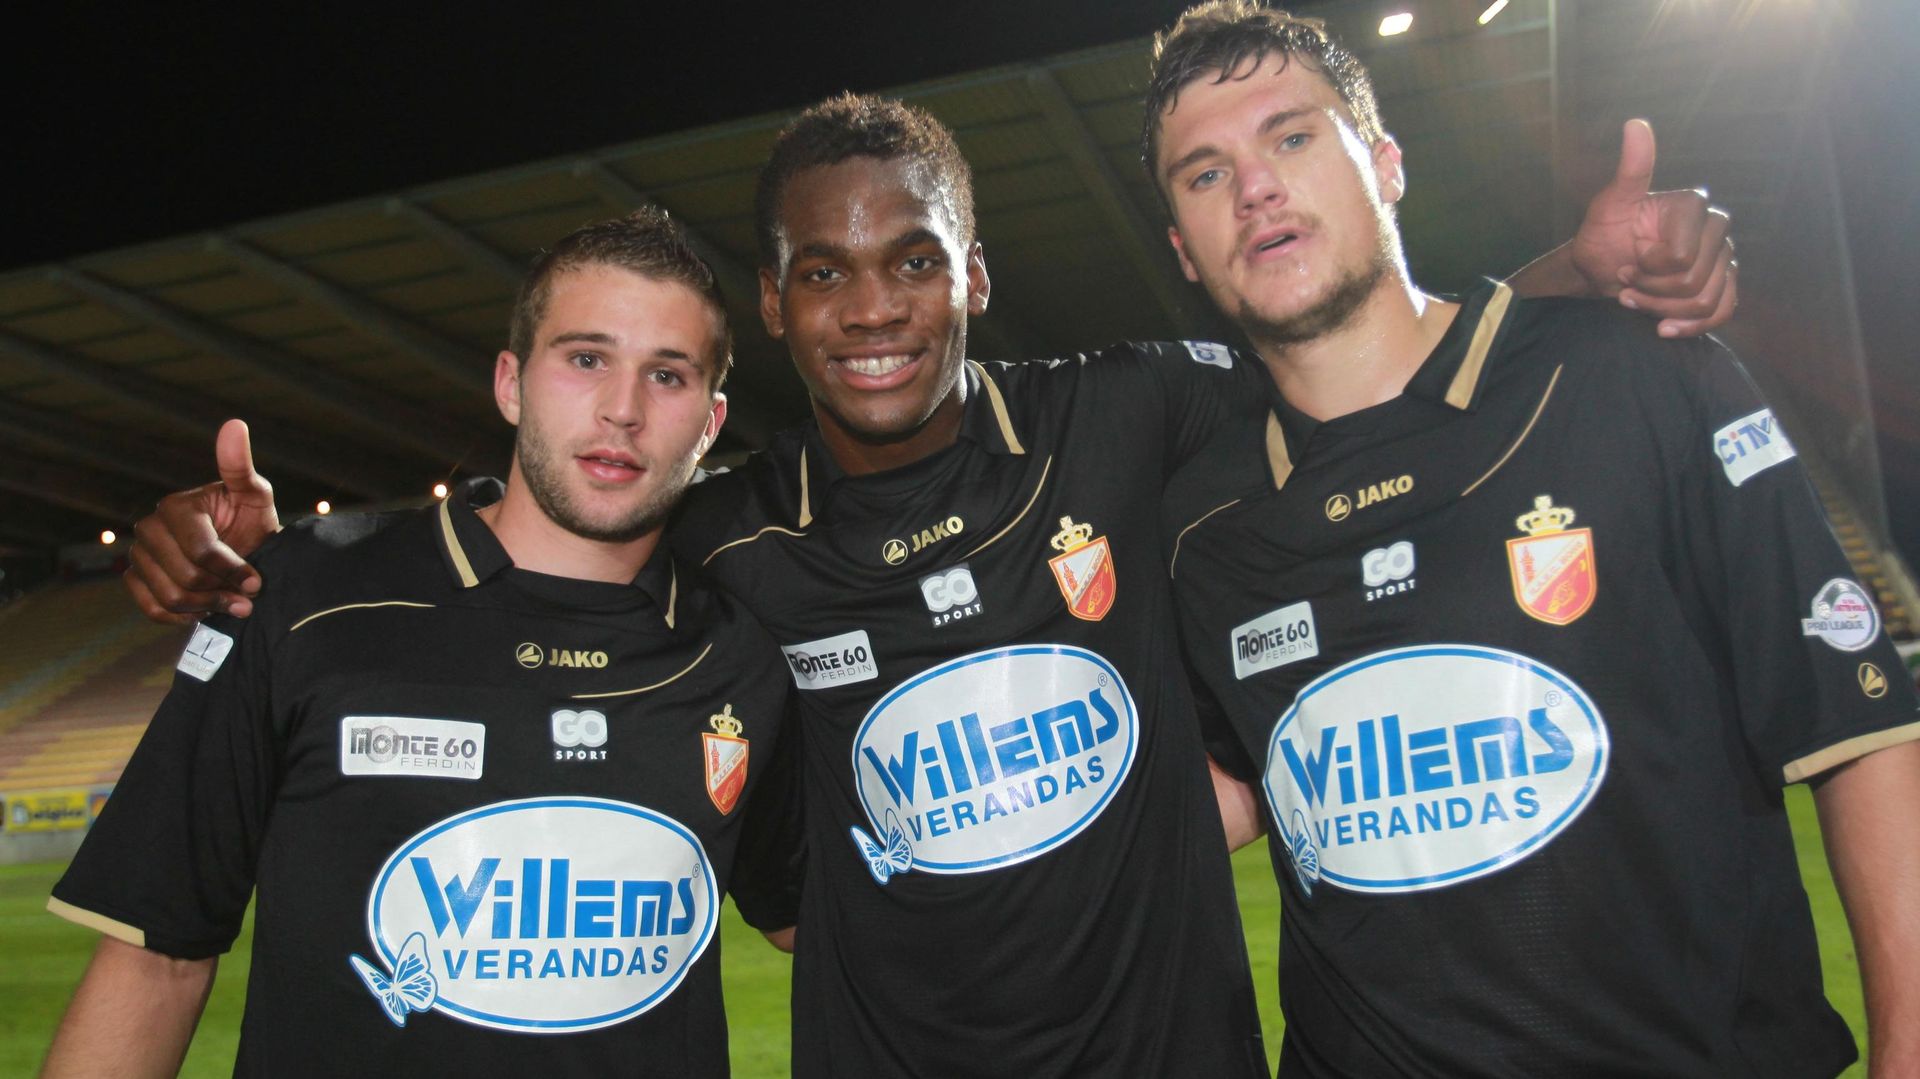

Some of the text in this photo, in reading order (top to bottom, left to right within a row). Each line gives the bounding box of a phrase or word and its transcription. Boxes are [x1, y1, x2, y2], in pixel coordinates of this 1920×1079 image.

[1356, 473, 1414, 510] JAKO
[911, 515, 964, 553] JAKO
[1361, 540, 1416, 588] GO
[920, 567, 979, 614] GO
[1366, 578, 1416, 601] SPORT
[933, 602, 982, 627] SPORT
[1286, 619, 1310, 643] 60
[548, 647, 609, 669] JAKO
[842, 645, 868, 667] 60
[1265, 638, 1313, 661] FERDIN
[821, 663, 873, 681] FERDIN
[551, 708, 608, 748] GO
[443, 737, 478, 760] 60
[555, 749, 608, 761] SPORT
[400, 756, 477, 771] FERDIN
[906, 754, 1106, 842] VERANDAS
[1314, 786, 1541, 850] VERANDAS
[442, 944, 670, 980] VERANDAS
